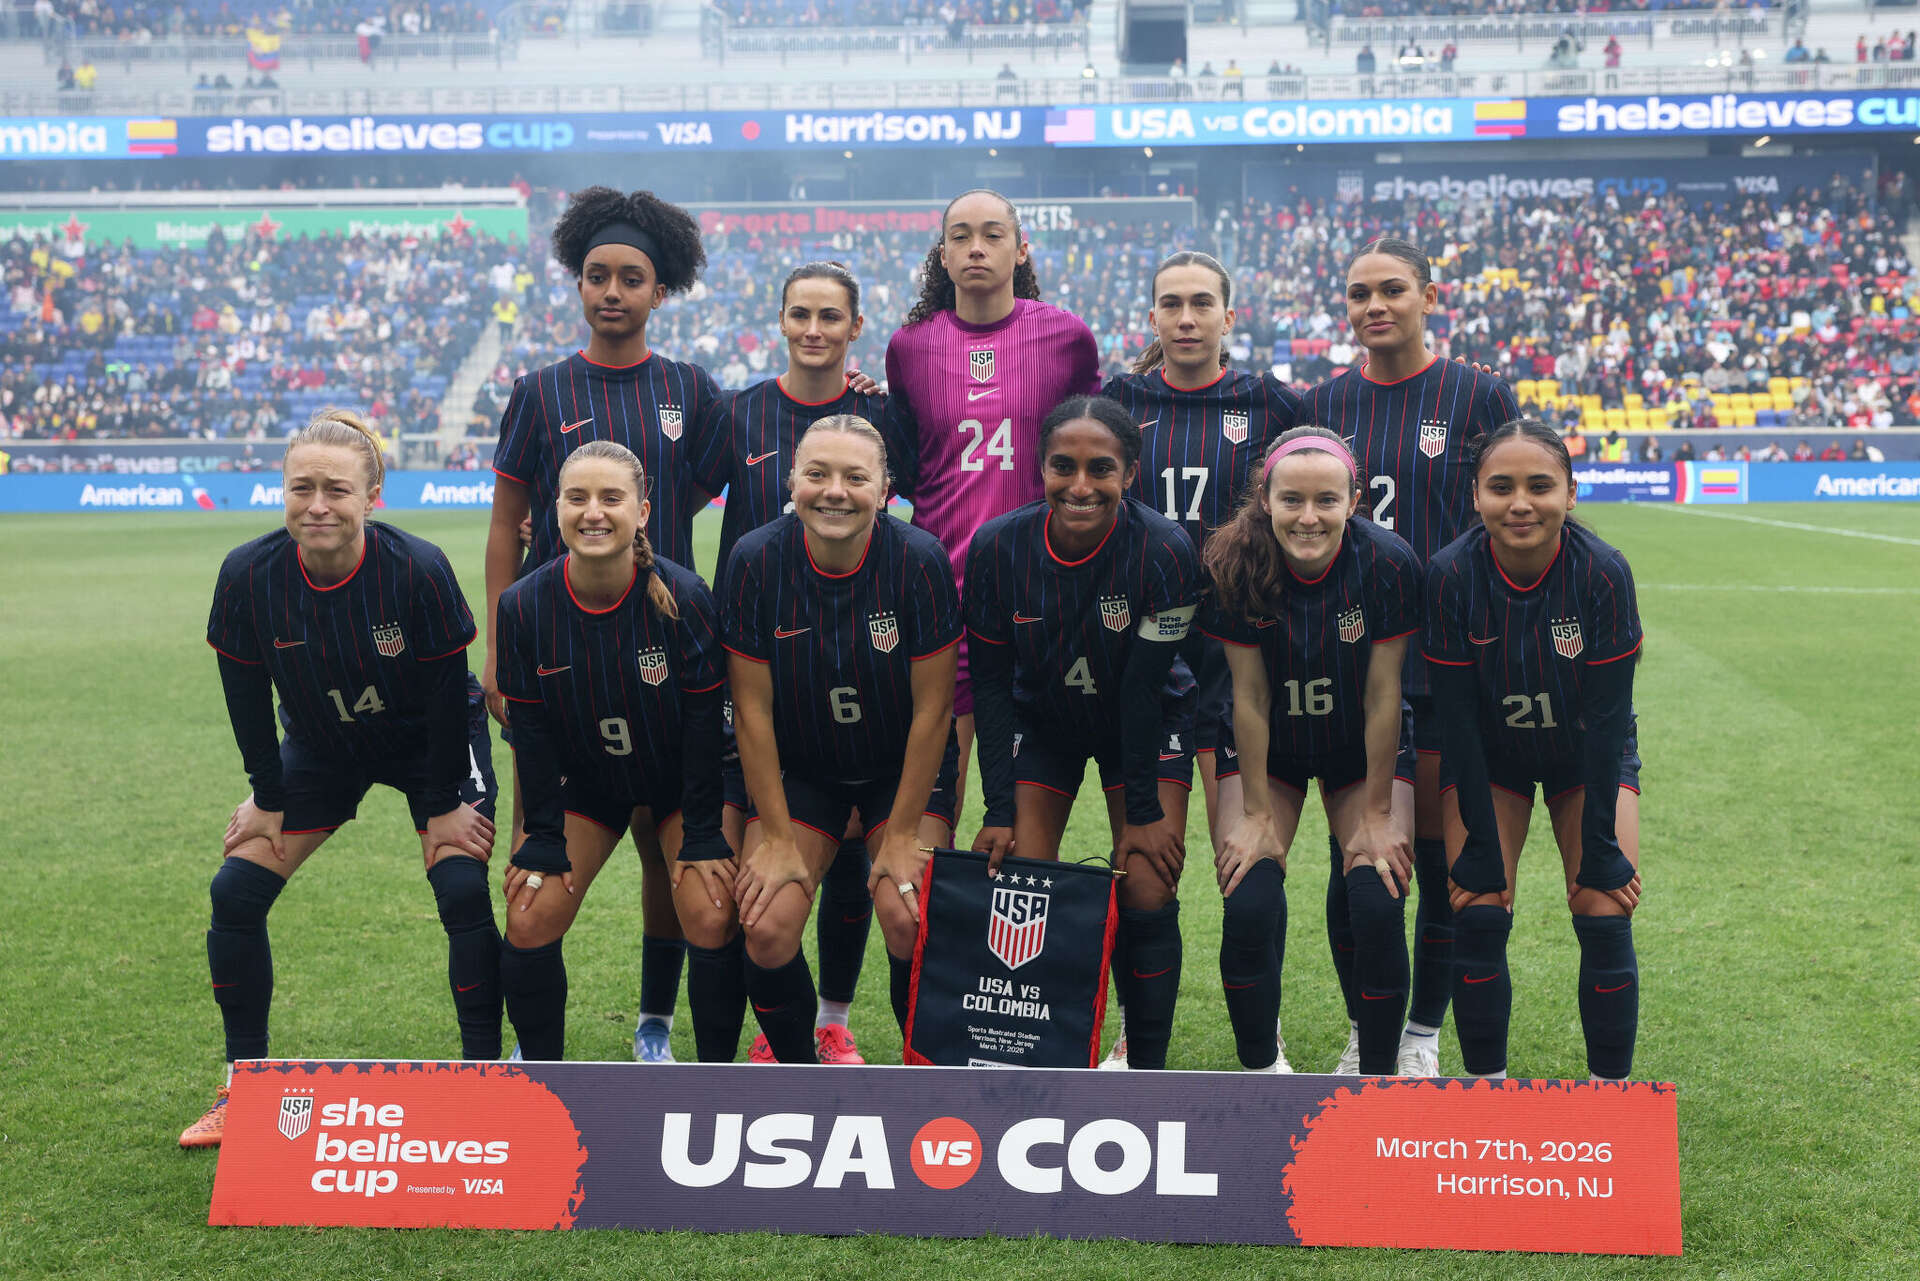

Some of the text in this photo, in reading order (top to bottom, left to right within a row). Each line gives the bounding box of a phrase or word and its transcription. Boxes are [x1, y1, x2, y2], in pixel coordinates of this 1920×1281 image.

[1111, 107, 1196, 139] USA
[1242, 103, 1453, 138] Colombia
[1557, 92, 1920, 133] shebelieves cu
[206, 117, 484, 152] shebelieves
[487, 121, 575, 151] cup
[656, 122, 713, 145] VISA
[785, 110, 1022, 143] Harrison, NJ
[815, 206, 943, 233] Illustrat
[1016, 204, 1073, 232] KETS
[971, 351, 993, 365] USA
[661, 410, 682, 424] USA
[1225, 415, 1247, 428] USA
[958, 418, 1014, 471] 24
[1422, 426, 1445, 439] USA
[80, 483, 183, 506] American
[420, 481, 496, 504] Americ
[1161, 467, 1209, 521] 17
[1370, 475, 1395, 530] 2
[1102, 602, 1128, 615] USA
[1340, 610, 1362, 628] USA
[375, 629, 401, 642] USA
[871, 619, 895, 634] USA
[1553, 625, 1580, 640] USA
[640, 654, 665, 668] USA
[1065, 656, 1097, 694] 4
[327, 685, 386, 722] 14
[829, 686, 862, 723] 6
[1284, 677, 1334, 716] 16
[1502, 692, 1558, 728] 21
[599, 717, 633, 756] 9
[994, 891, 1047, 926] USA
[979, 976, 1041, 1000] USA VS
[962, 993, 1050, 1021] COLOMBIA
[967, 1025, 1041, 1041] Sports Illustrated Stadium
[998, 1037, 1013, 1045] New
[1014, 1039, 1034, 1049] Jersey
[979, 1042, 998, 1051] March
[1006, 1045, 1025, 1054] 2026
[282, 1098, 311, 1116] USA
[320, 1097, 405, 1127] she
[314, 1132, 510, 1164] believes
[660, 1112, 896, 1189] USA
[996, 1117, 1219, 1197] COL
[1376, 1137, 1613, 1164] March 7th, 2026
[311, 1168, 399, 1197] cup
[407, 1178, 504, 1195] Presented by VISA
[1436, 1173, 1614, 1200] Harrison, NJ
